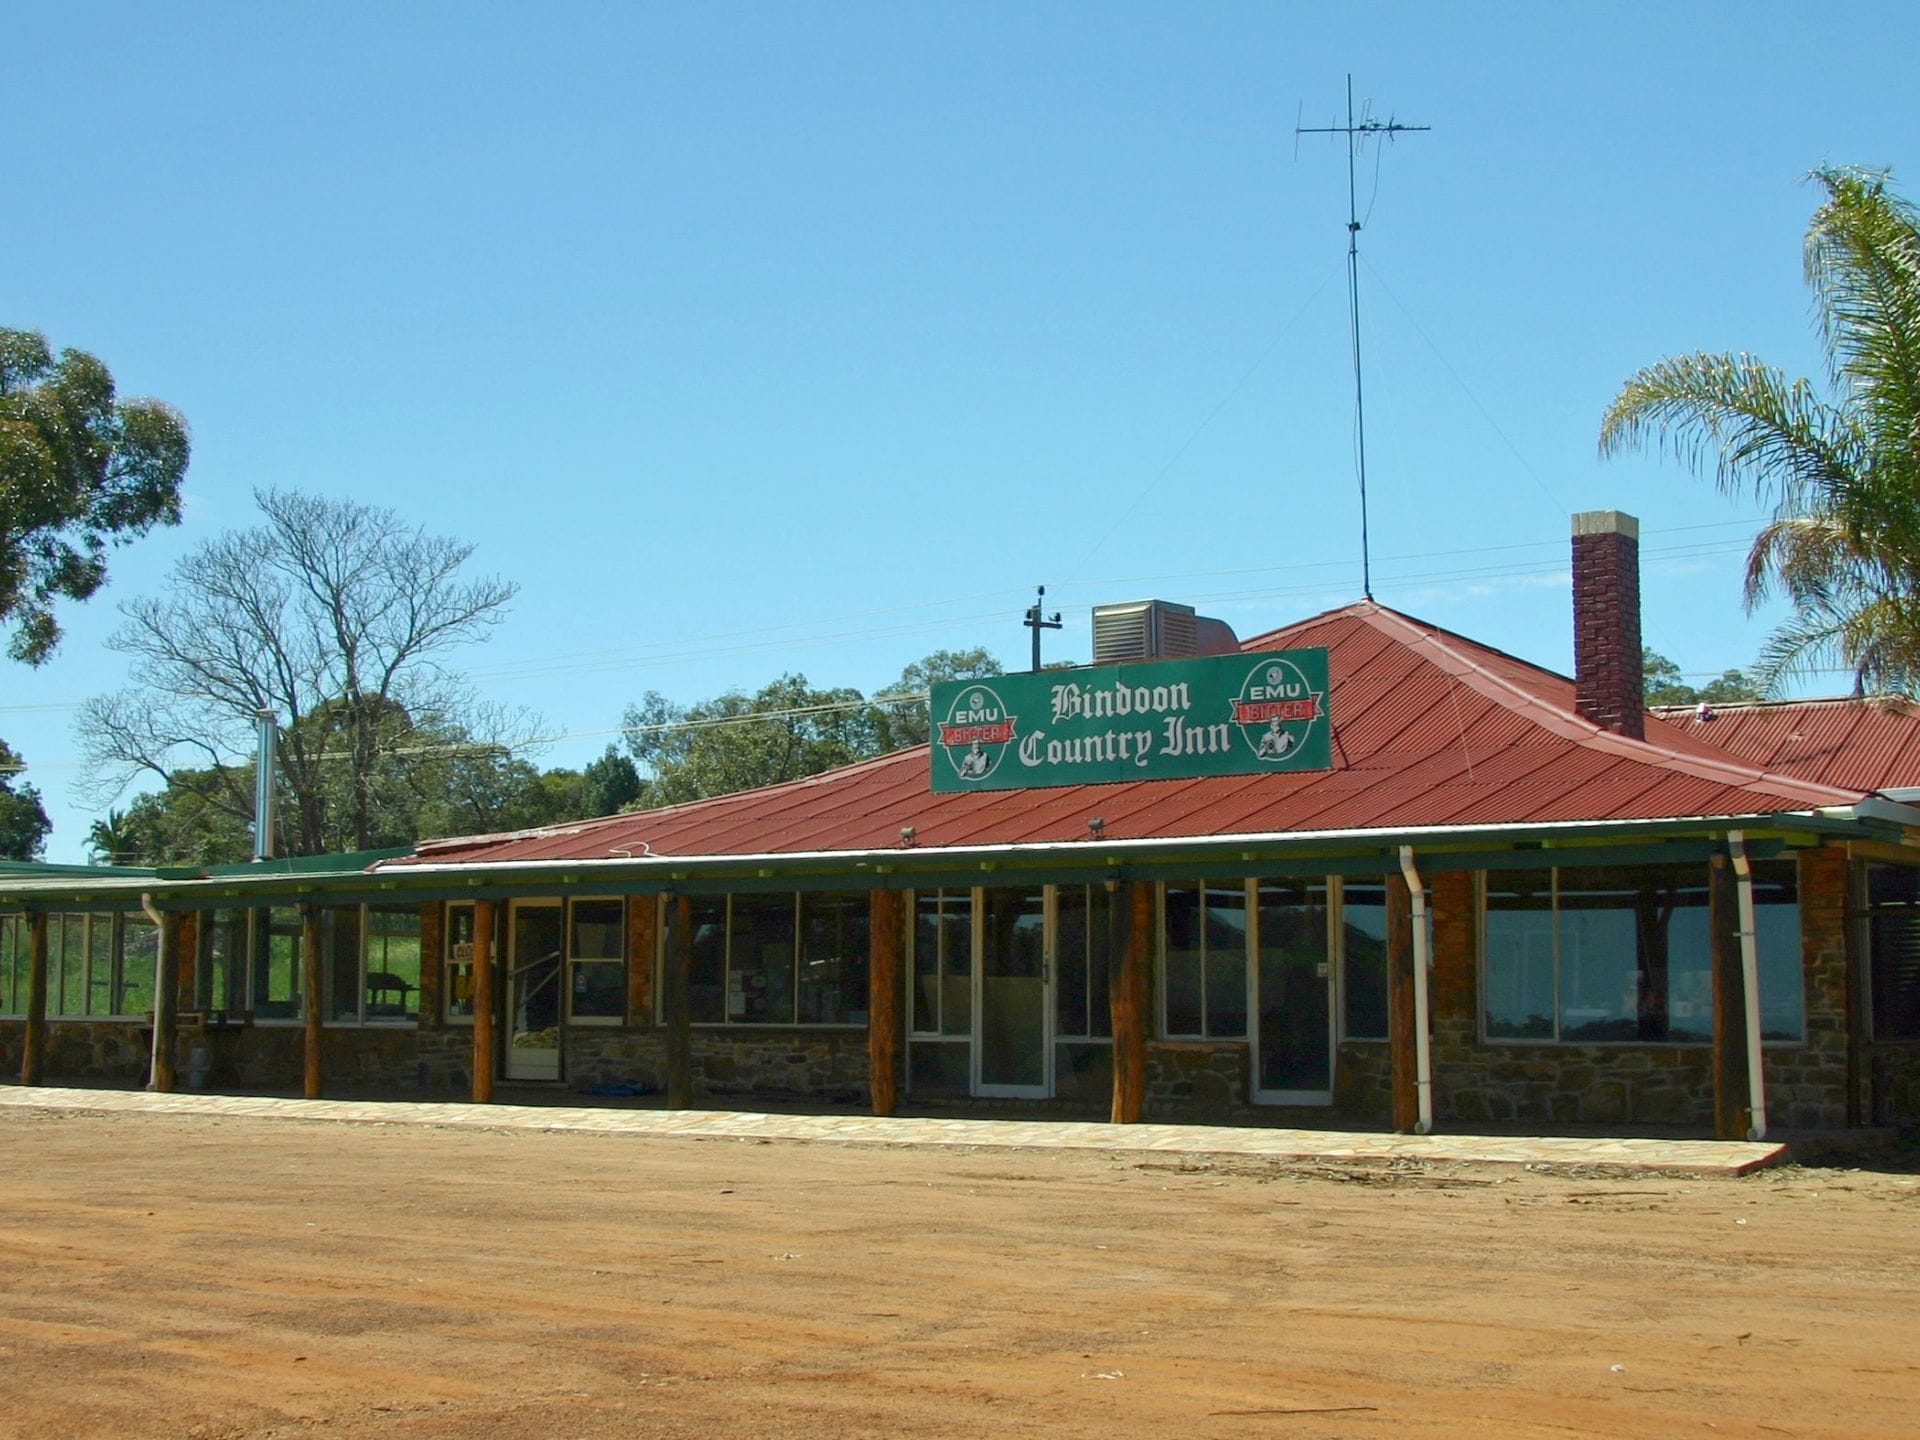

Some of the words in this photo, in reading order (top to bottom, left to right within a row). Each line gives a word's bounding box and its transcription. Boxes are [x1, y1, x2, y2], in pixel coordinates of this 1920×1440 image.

[1051, 681, 1191, 725] Bindoon
[1250, 683, 1300, 700] EMU
[955, 708, 998, 724] EMU
[1018, 729, 1153, 767] Country
[1159, 715, 1231, 757] Inn
